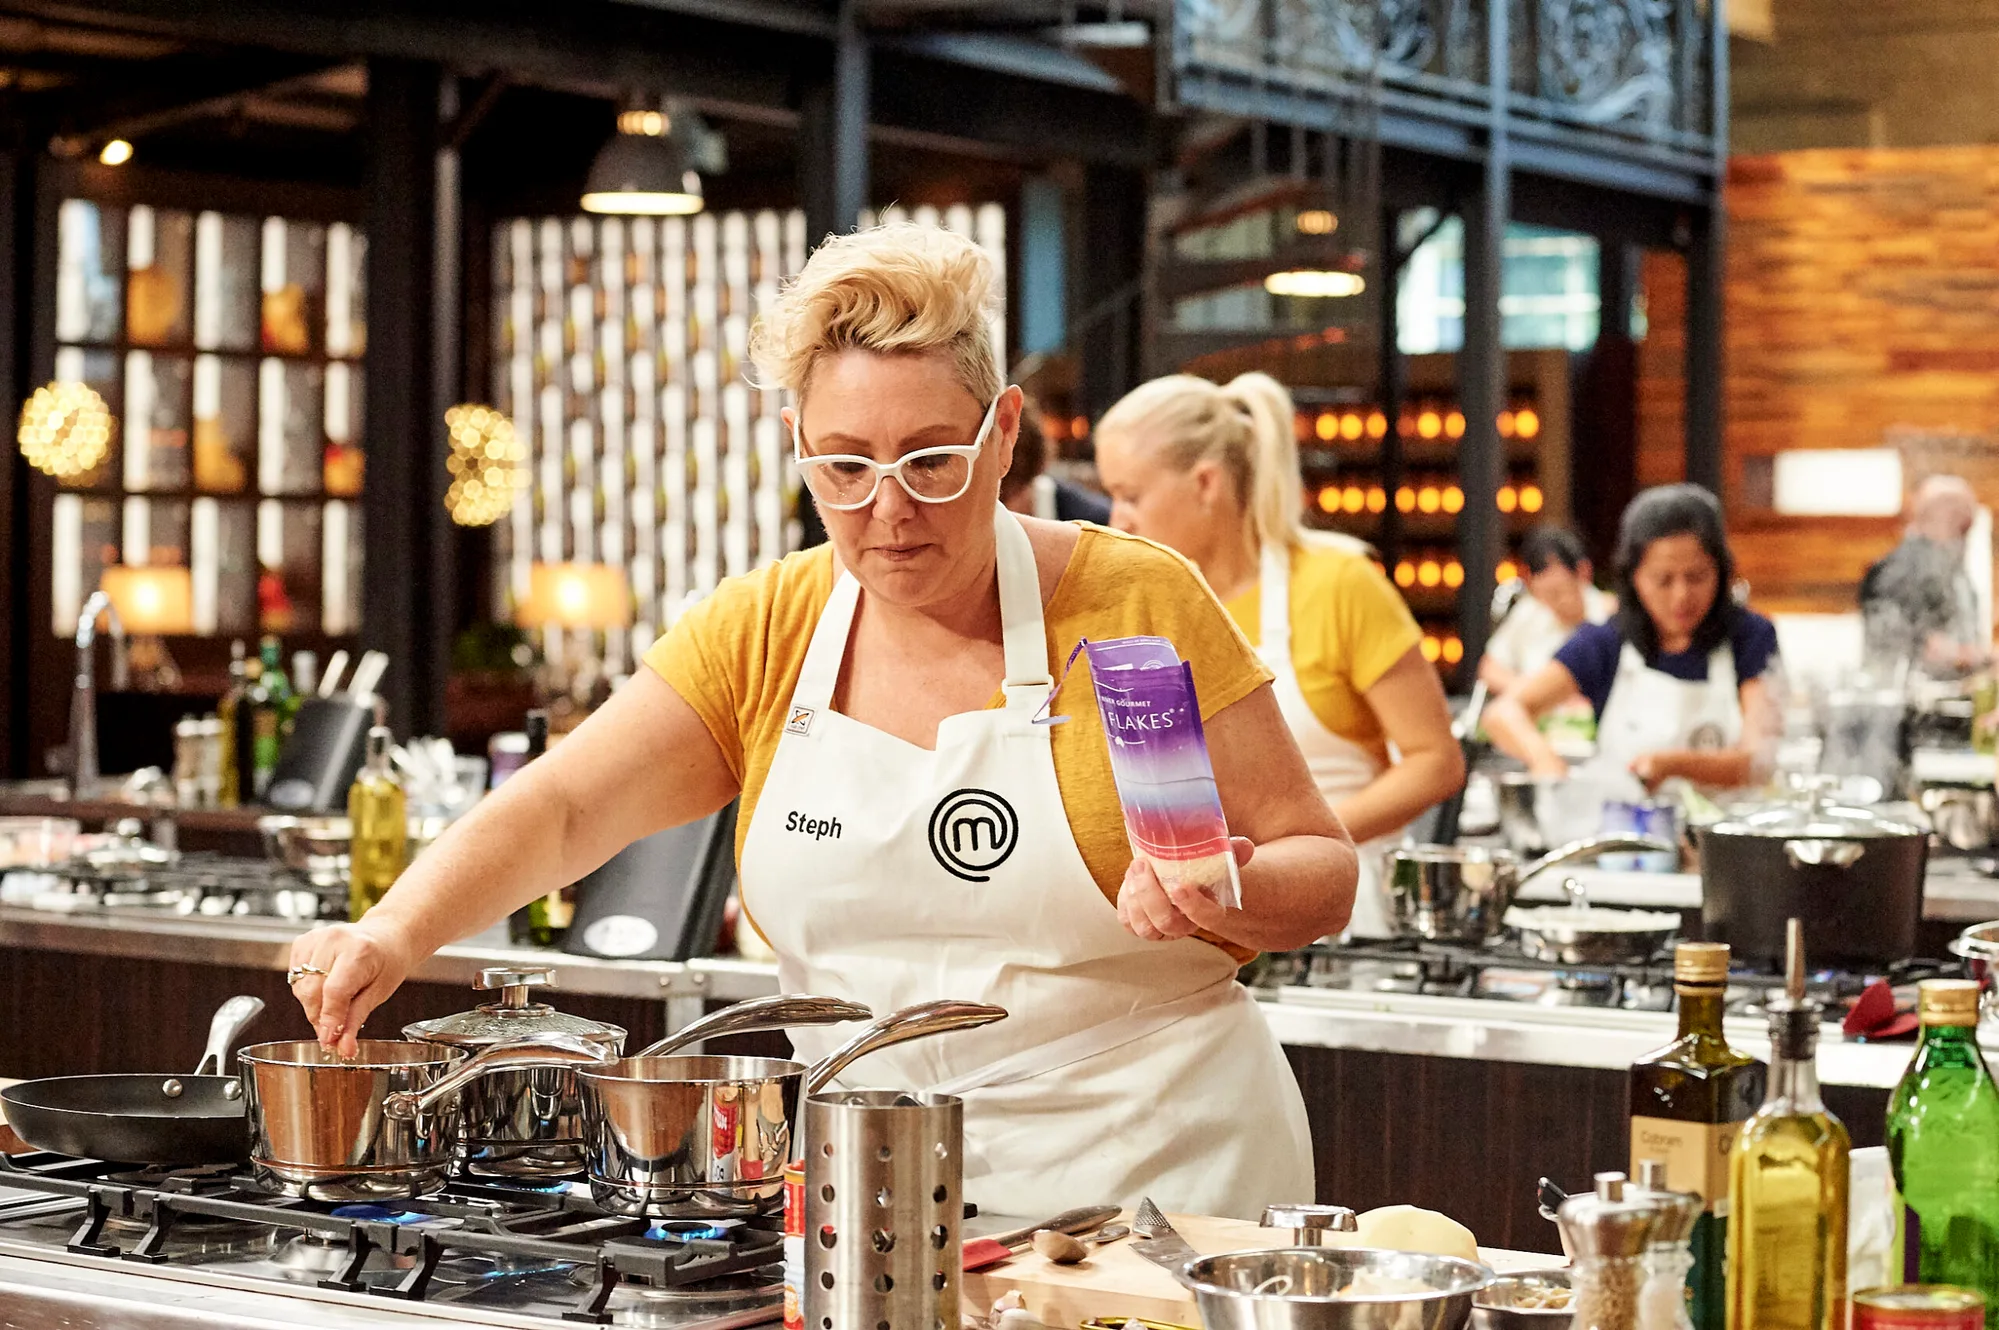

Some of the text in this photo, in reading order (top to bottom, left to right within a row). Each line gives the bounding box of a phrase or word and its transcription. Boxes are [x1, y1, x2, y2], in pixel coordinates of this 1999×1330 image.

[1116, 699, 1151, 708] GOURMET
[1108, 712, 1174, 730] FLAKES
[785, 811, 842, 841] Steph
